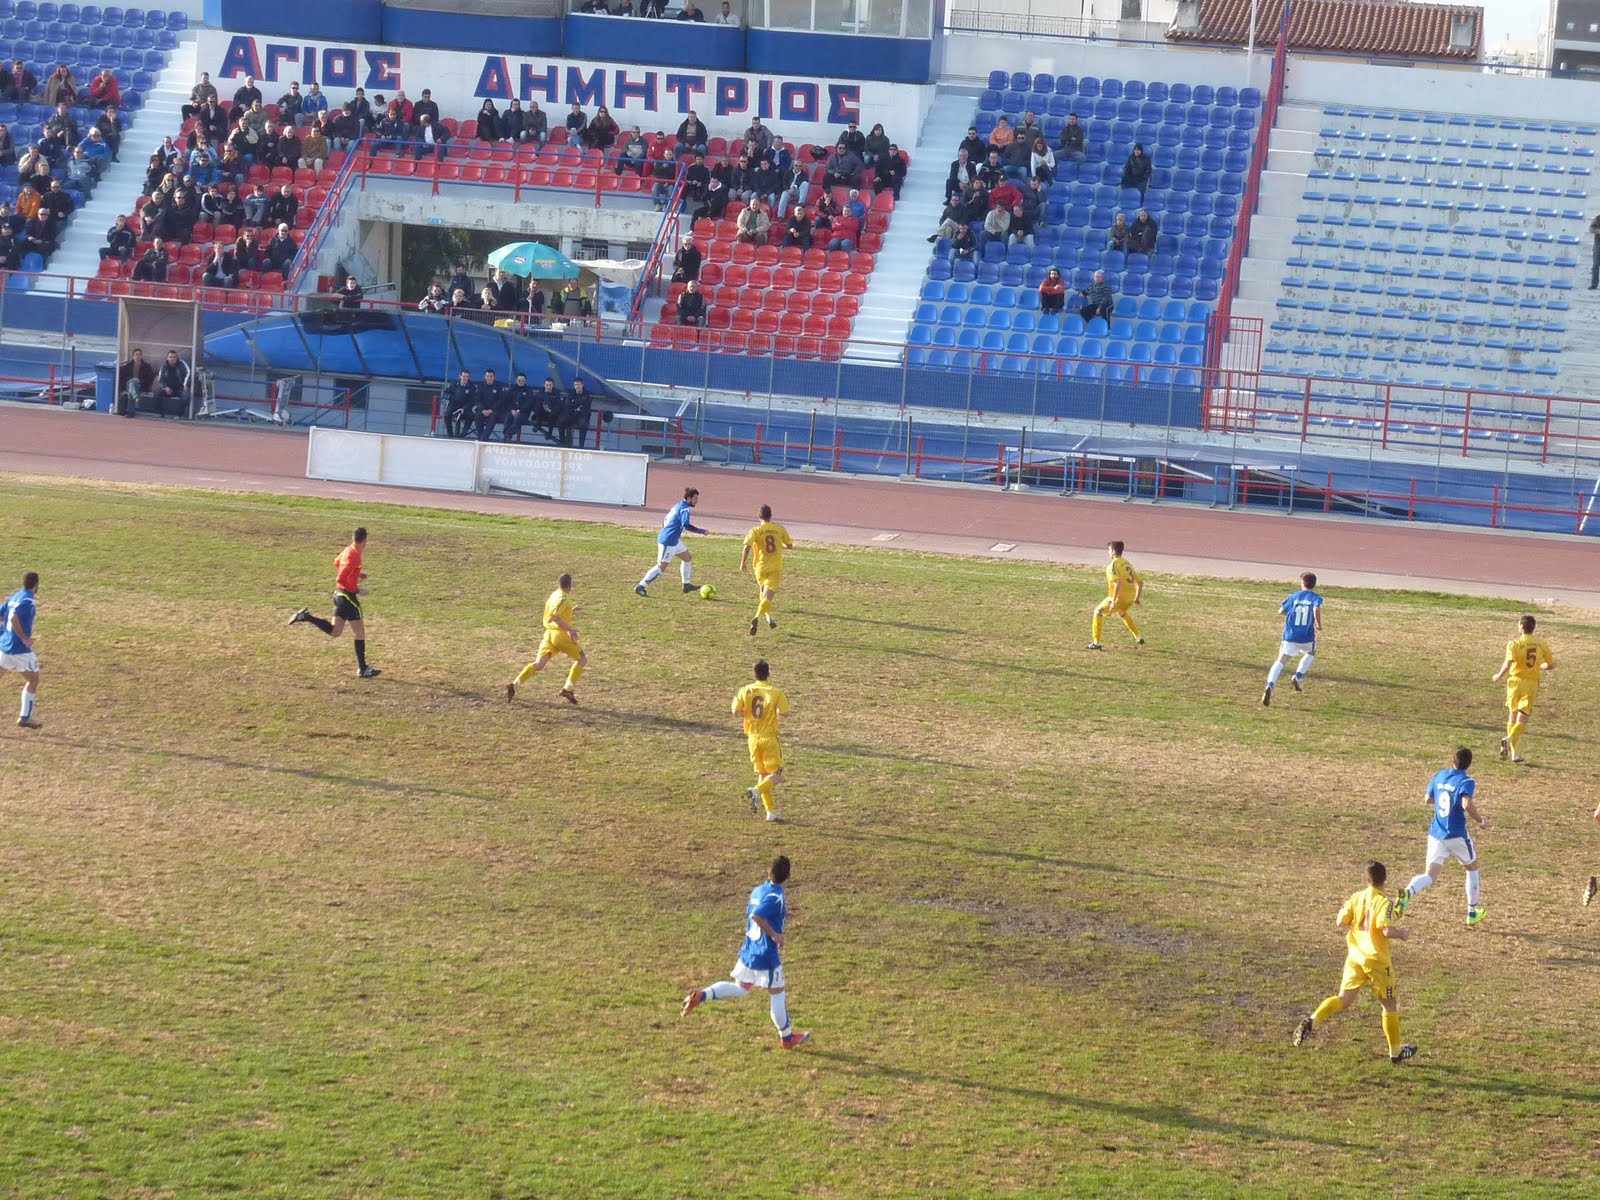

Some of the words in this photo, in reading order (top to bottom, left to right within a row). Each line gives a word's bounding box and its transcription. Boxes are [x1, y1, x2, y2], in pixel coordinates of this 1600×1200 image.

[218, 36, 401, 91] ΑΓΙΟΣ
[473, 56, 861, 126] ΔΗΜΗΤΡΙΟΣ
[765, 534, 777, 554] 8
[1125, 566, 1135, 583] 3
[1294, 605, 1309, 626] 11
[1526, 648, 1537, 669] 5
[751, 695, 765, 720] 6
[1439, 791, 1450, 818] 9
